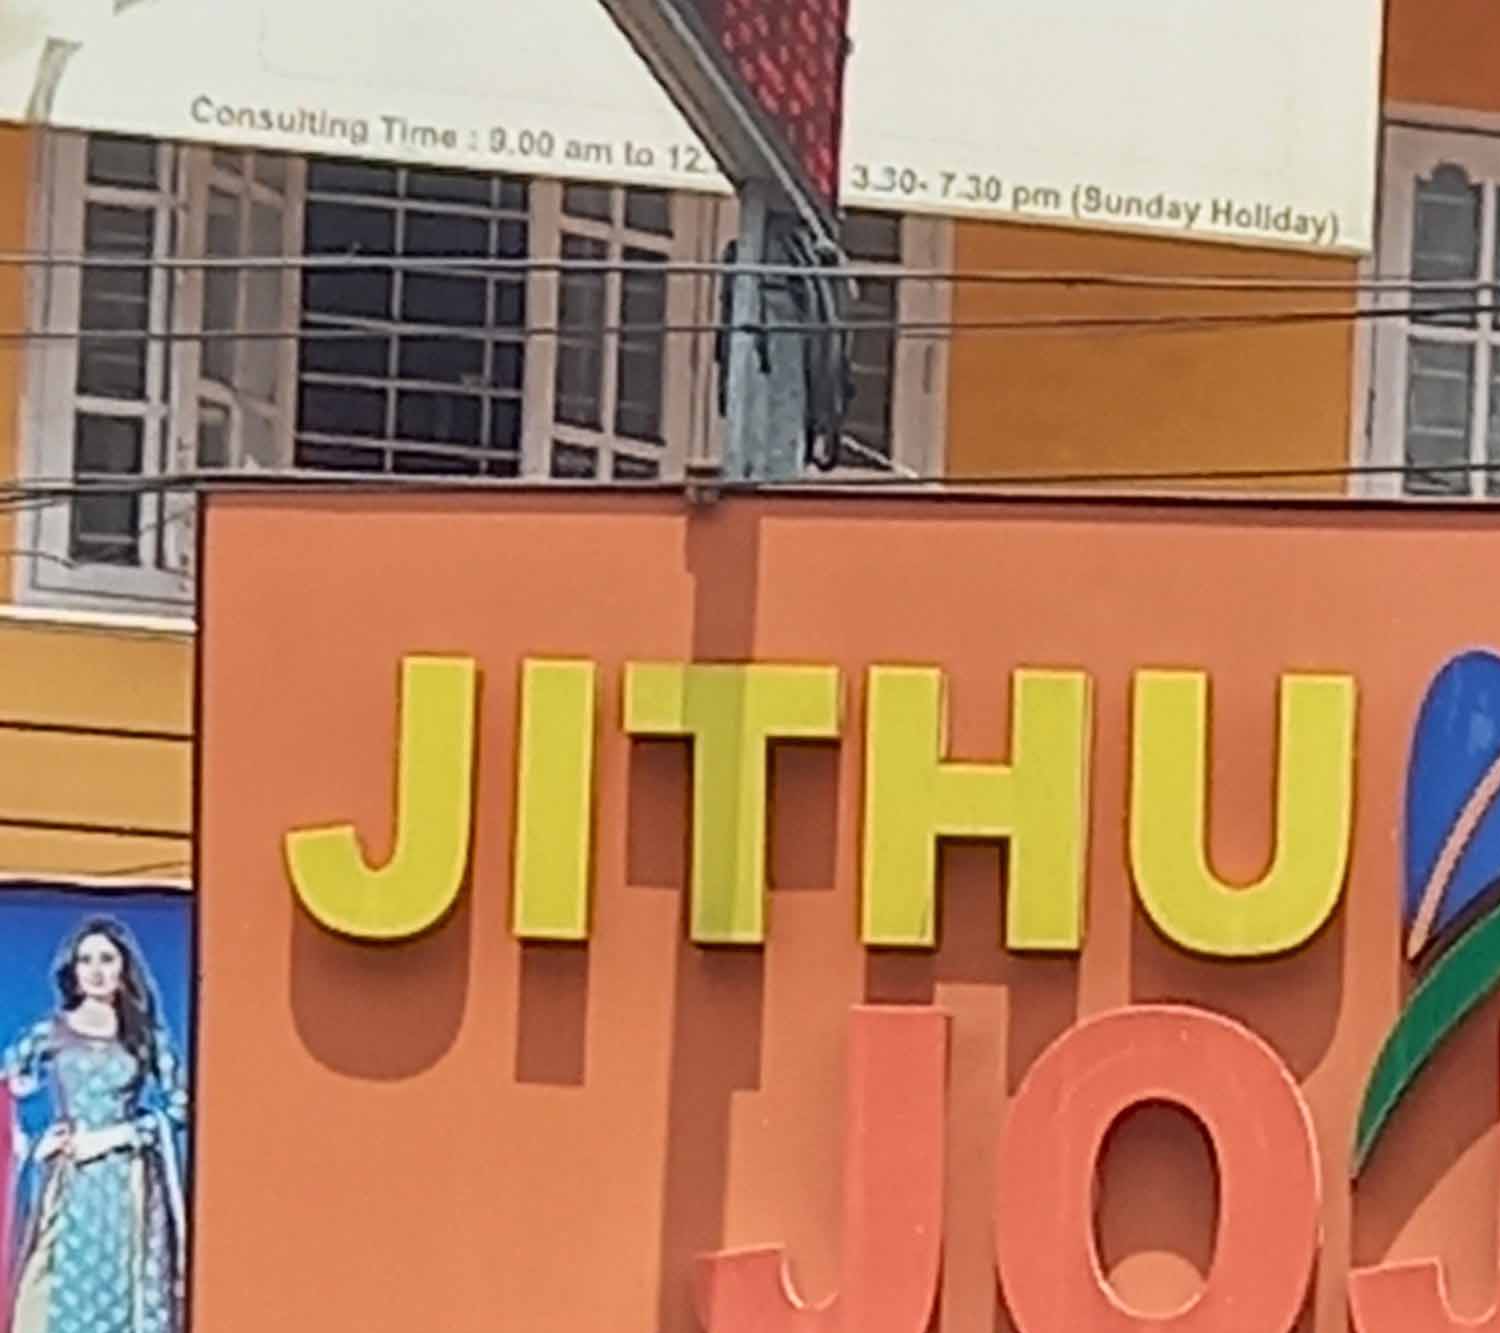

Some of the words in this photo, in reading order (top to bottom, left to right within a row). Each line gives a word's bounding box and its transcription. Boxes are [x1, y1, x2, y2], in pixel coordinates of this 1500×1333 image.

[191, 95, 370, 145] Consulting
[380, 114, 458, 148] Time
[490, 126, 555, 157] 9.00
[565, 140, 613, 165] am
[623, 139, 655, 168] to
[939, 171, 1003, 203] 7.30
[1011, 184, 1061, 213] pm
[1071, 182, 1201, 228] (Sunday
[1211, 199, 1342, 244] Holiday)
[286, 655, 1358, 958] JITHU
